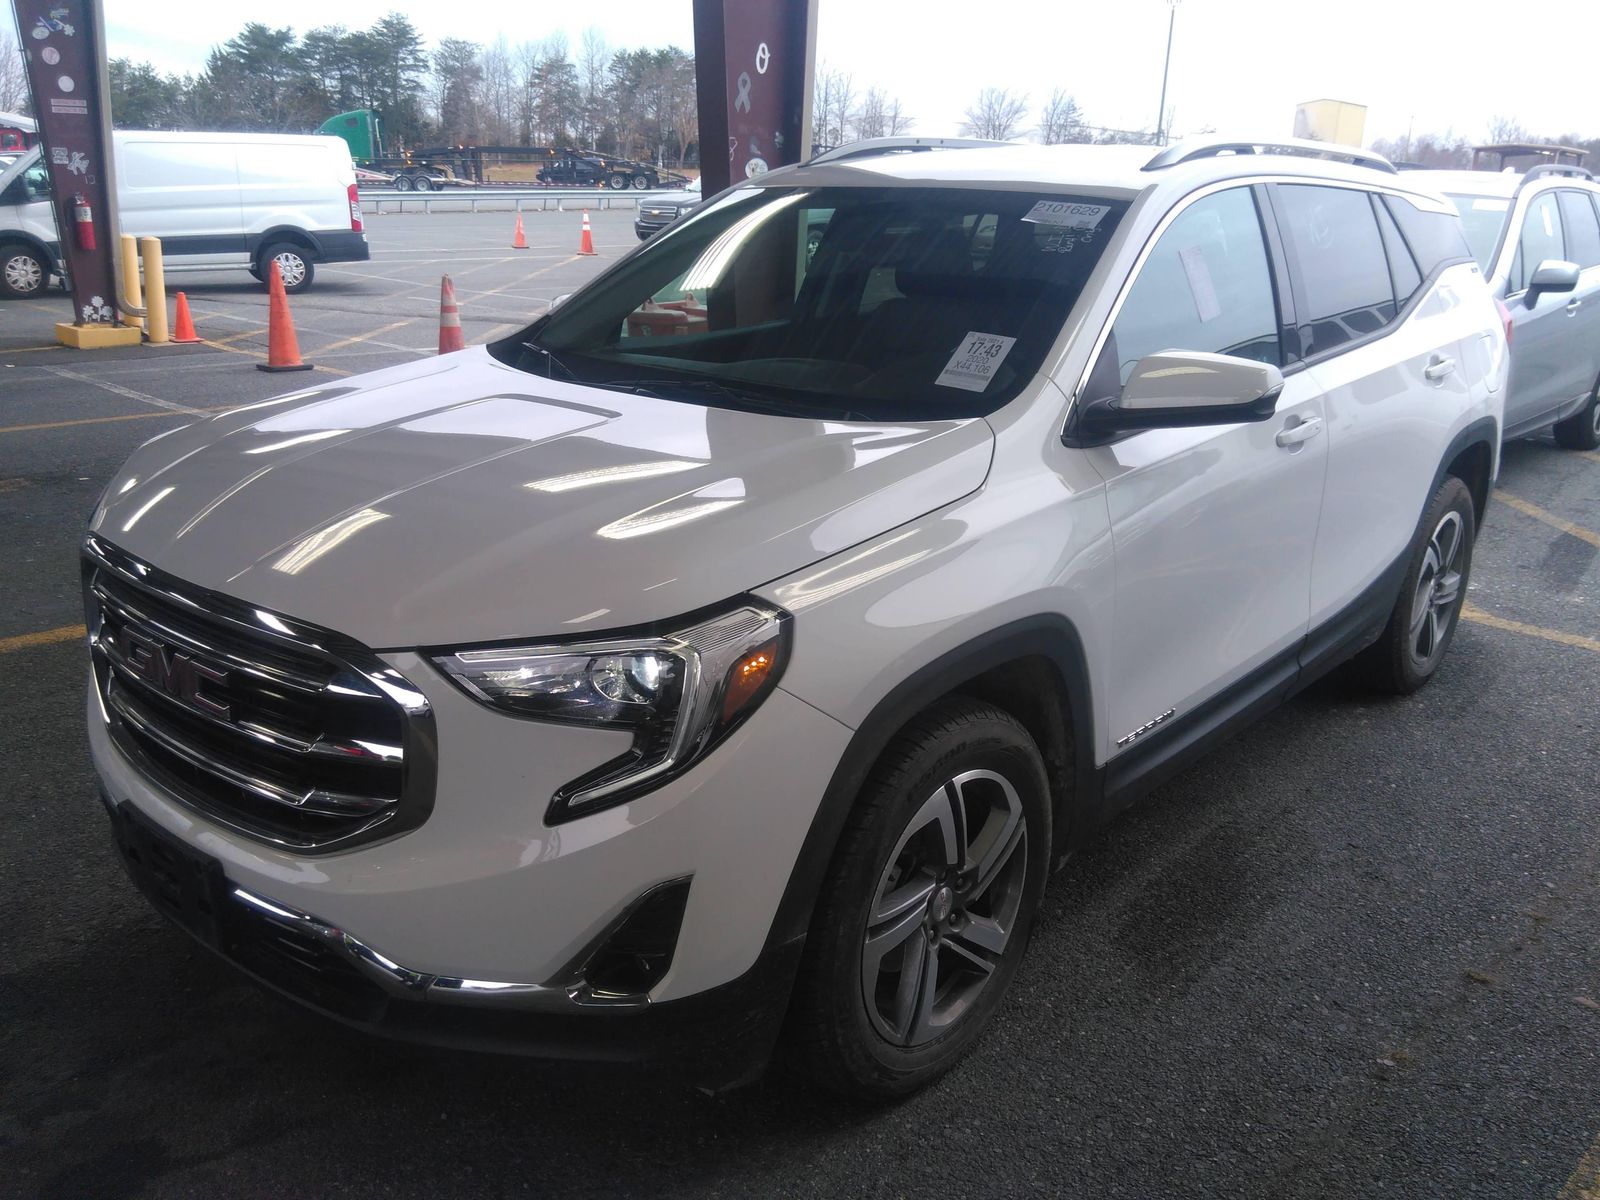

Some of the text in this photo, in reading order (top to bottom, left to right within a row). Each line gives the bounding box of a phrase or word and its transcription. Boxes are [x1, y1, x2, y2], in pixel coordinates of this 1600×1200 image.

[1033, 202, 1101, 216] 2101629
[967, 341, 1002, 358] 17:43
[967, 354, 990, 365] 2020
[121, 625, 230, 721] GMC
